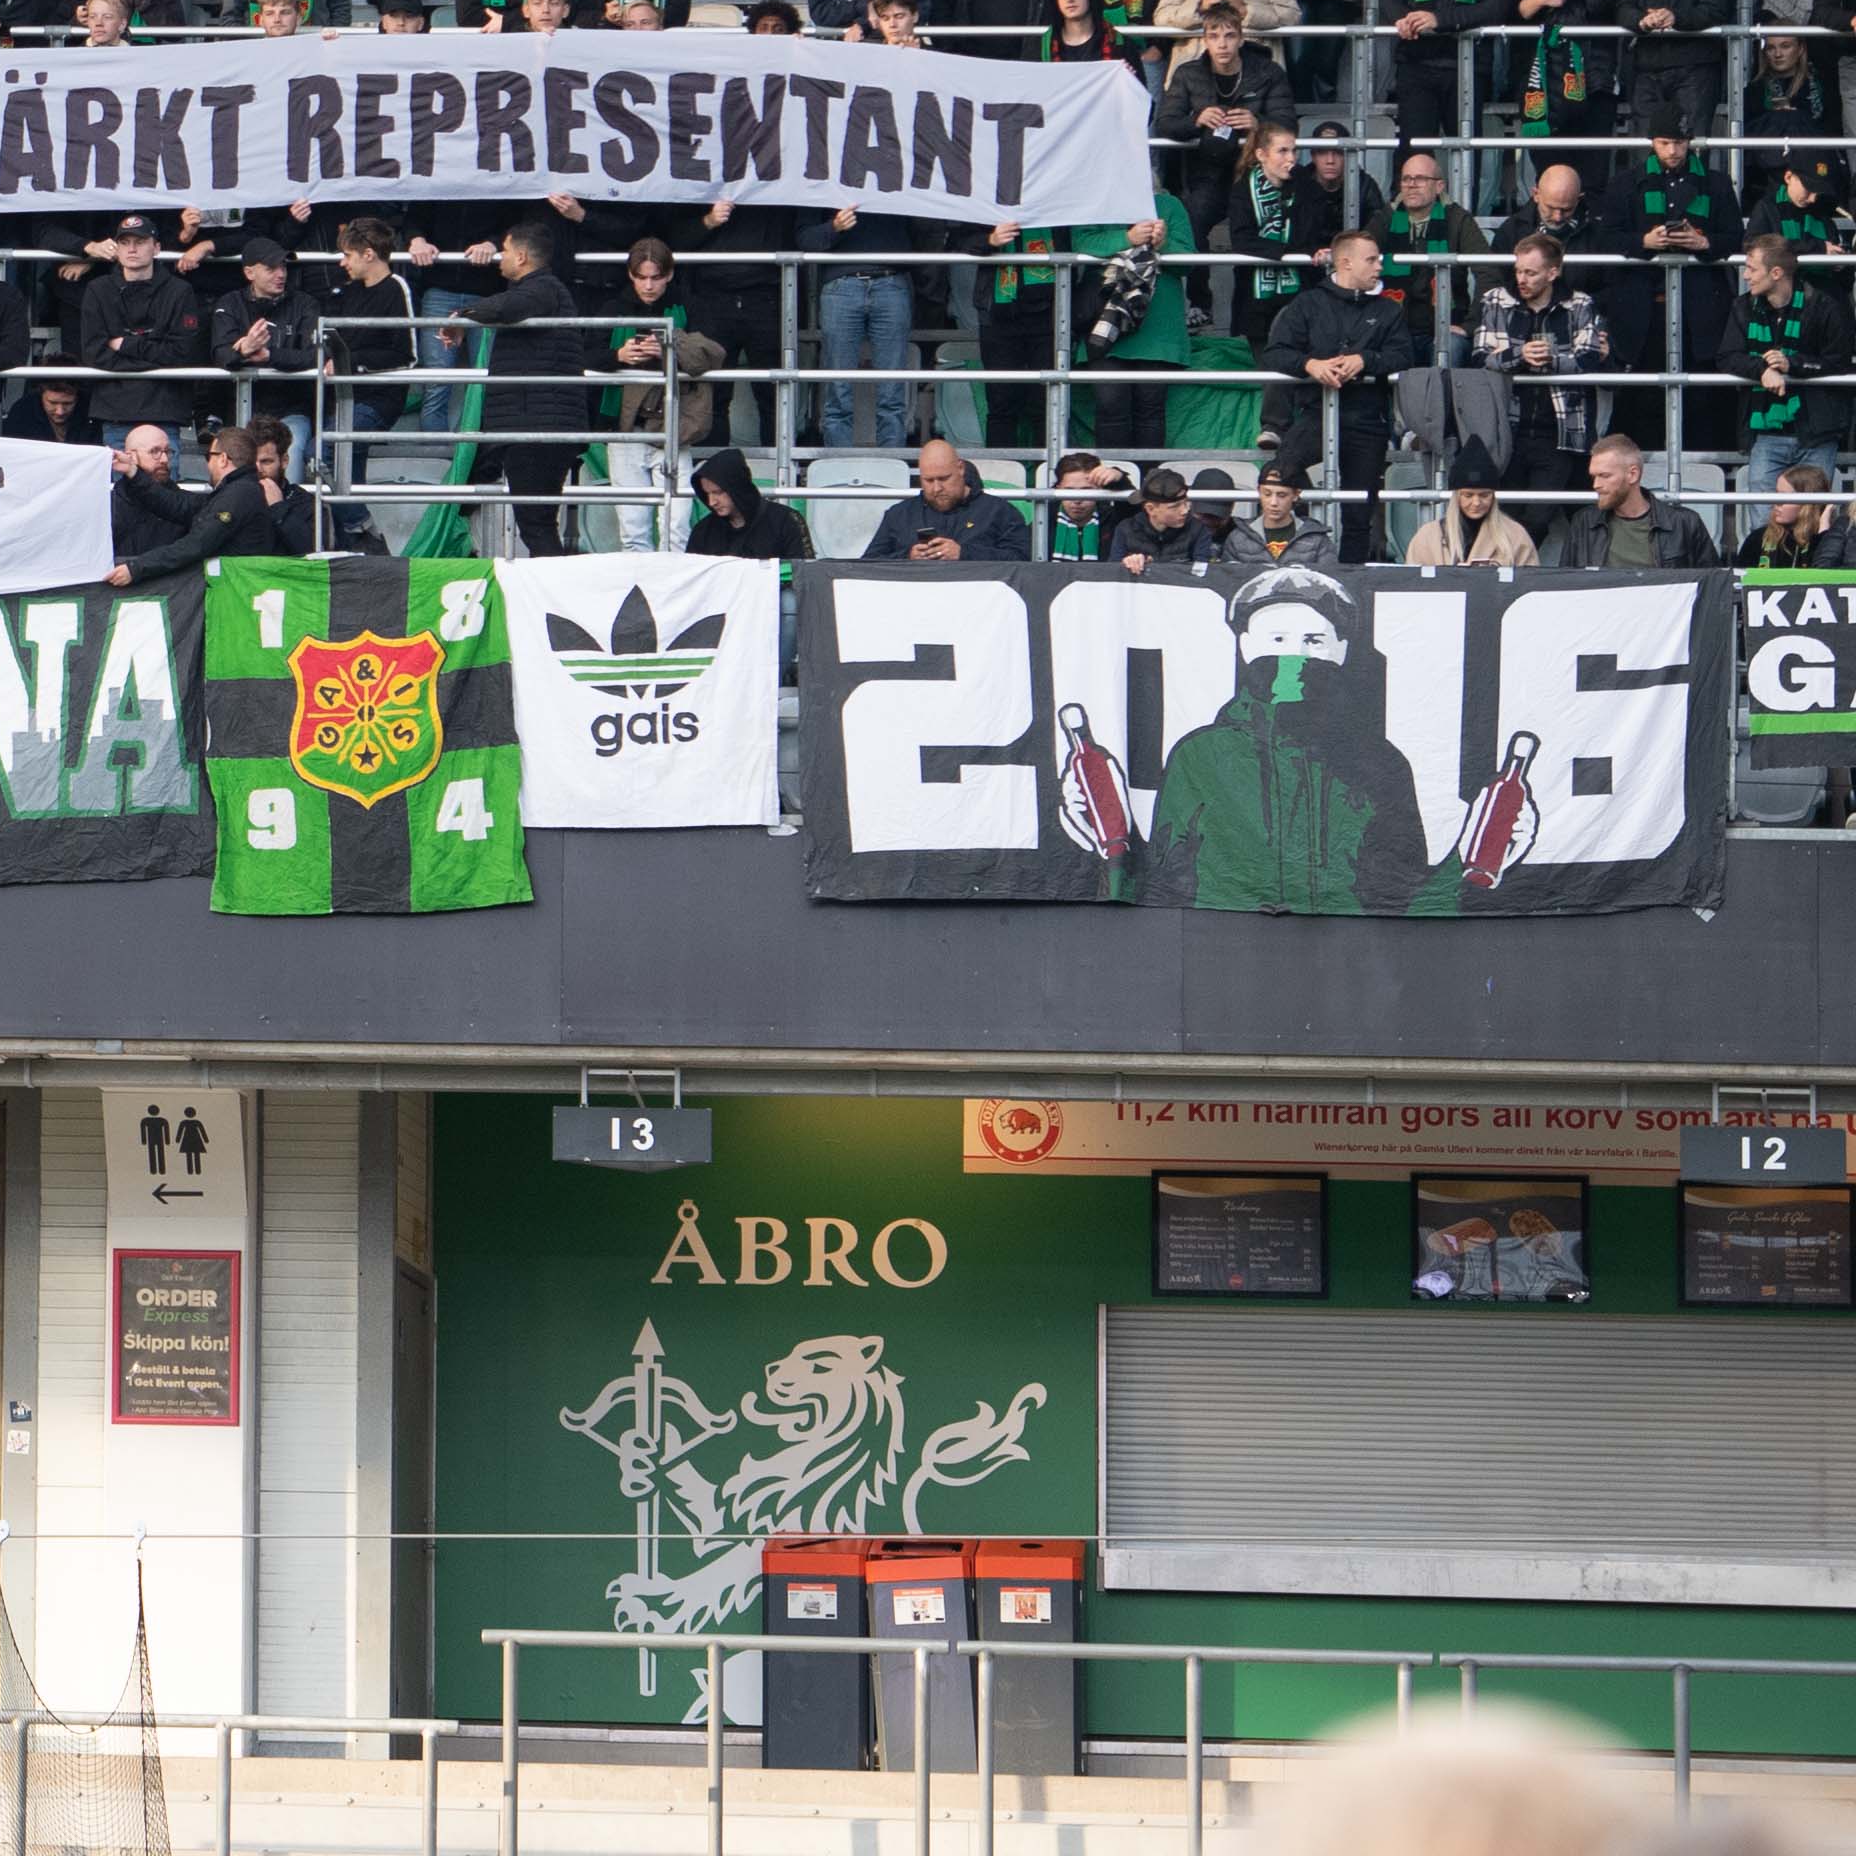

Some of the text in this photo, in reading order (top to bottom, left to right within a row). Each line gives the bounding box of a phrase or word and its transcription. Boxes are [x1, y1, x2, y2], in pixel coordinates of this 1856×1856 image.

[287, 67, 1044, 206] REPRESENTANT
[591, 703, 699, 757] gais
[833, 580, 1699, 866] 2016
[611, 1117, 655, 1151] 13
[1546, 1108, 1623, 1130] korv
[1636, 1109, 1706, 1131] som
[1741, 1137, 1787, 1171] 12
[651, 1199, 948, 1288] ÅBRO
[136, 1288, 217, 1308] ORDER
[143, 1308, 209, 1325] Express
[124, 1334, 229, 1353] Skippa kön!
[182, 1363, 216, 1375] betala
